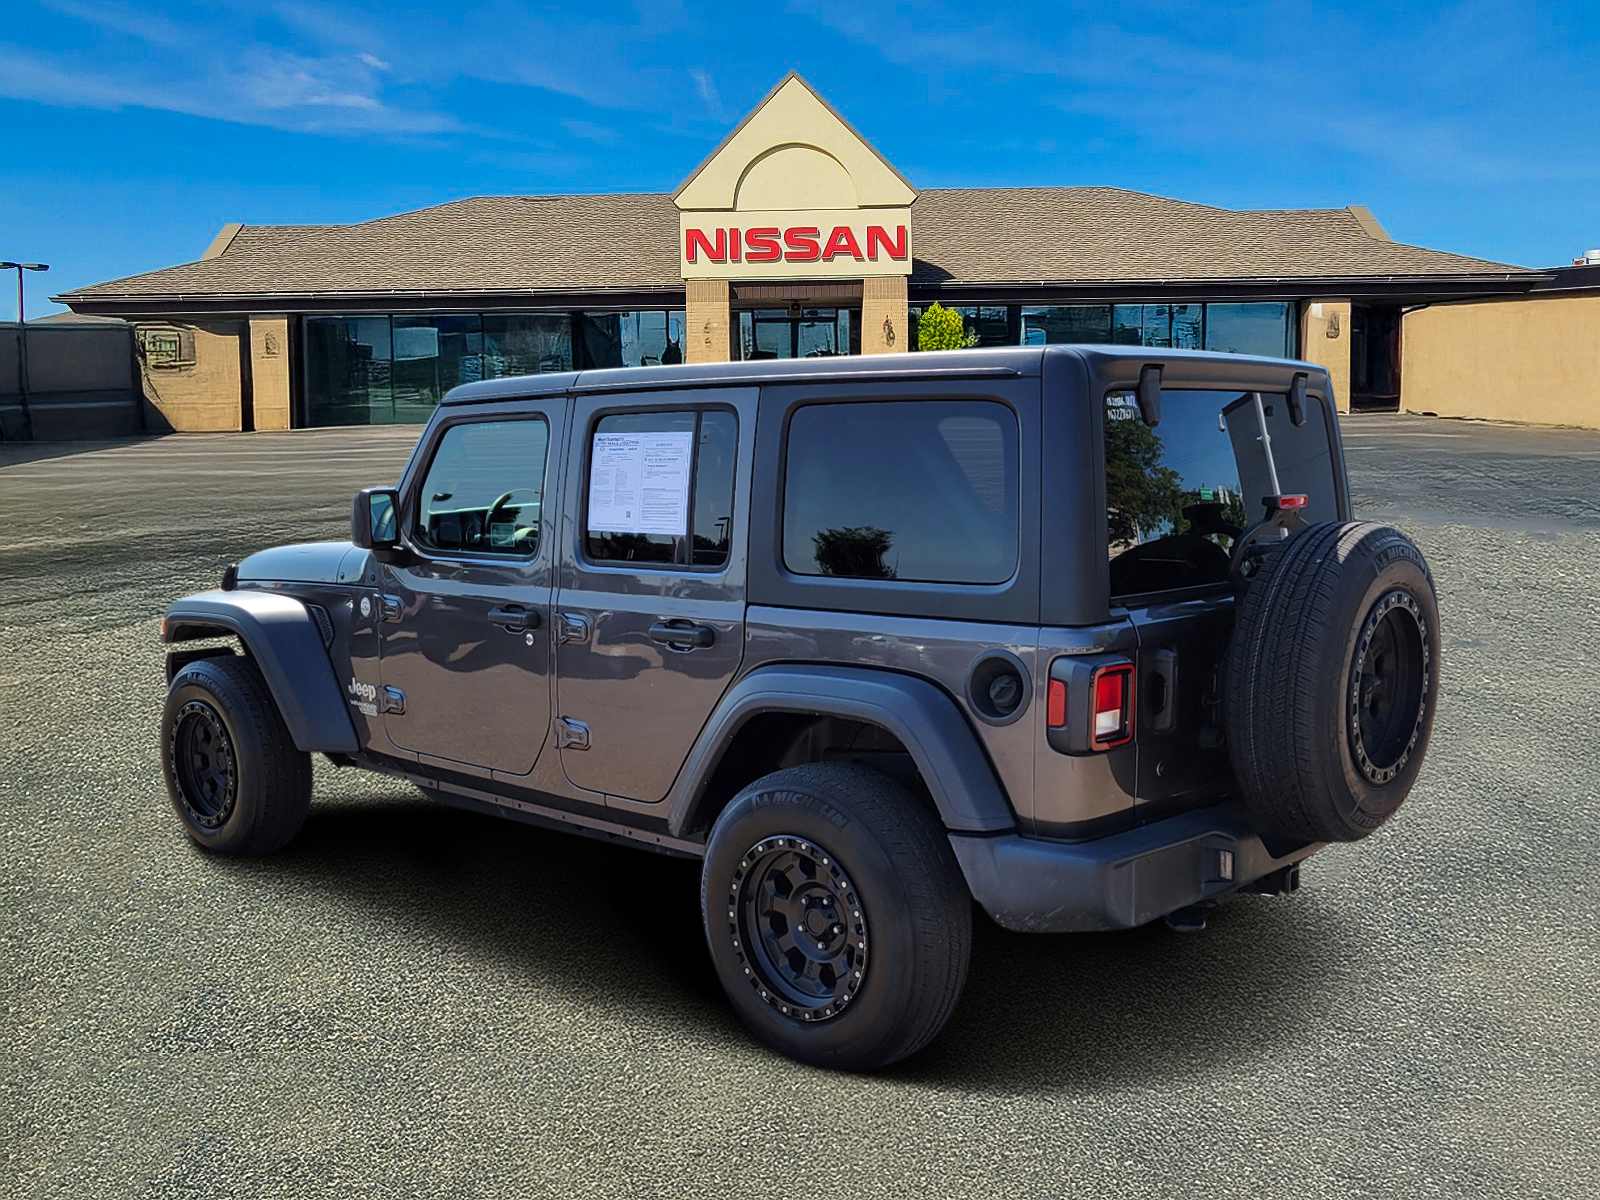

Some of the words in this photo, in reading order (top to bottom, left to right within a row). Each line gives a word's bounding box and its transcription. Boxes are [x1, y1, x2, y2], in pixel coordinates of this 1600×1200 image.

[685, 225, 908, 264] NISSAN
[347, 677, 377, 702] Jeep
[772, 790, 849, 828] MICHELIN
